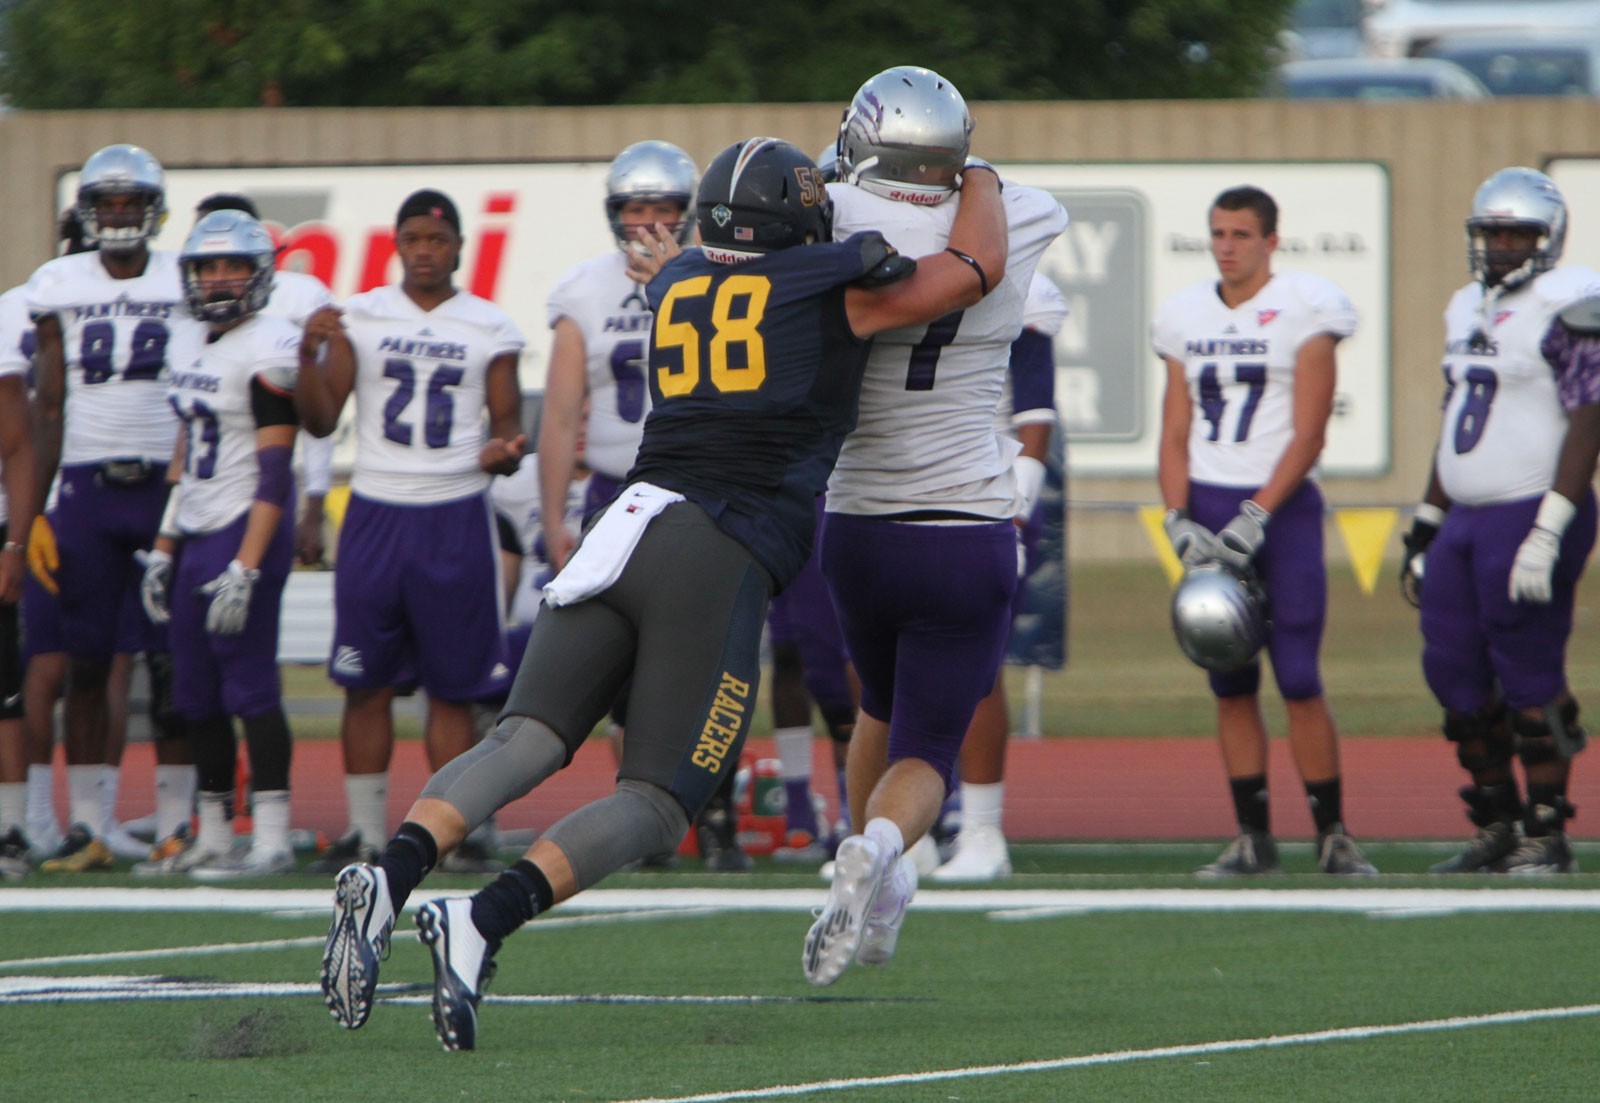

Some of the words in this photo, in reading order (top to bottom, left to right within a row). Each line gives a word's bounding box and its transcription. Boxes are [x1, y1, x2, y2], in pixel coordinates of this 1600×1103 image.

[378, 336, 467, 360] PANTHERS
[610, 338, 646, 424] 6
[656, 275, 772, 399] 58
[1184, 338, 1268, 357] PANTHERS
[382, 358, 465, 449] 26
[1442, 364, 1498, 455] 8
[692, 671, 750, 774] RACERS
